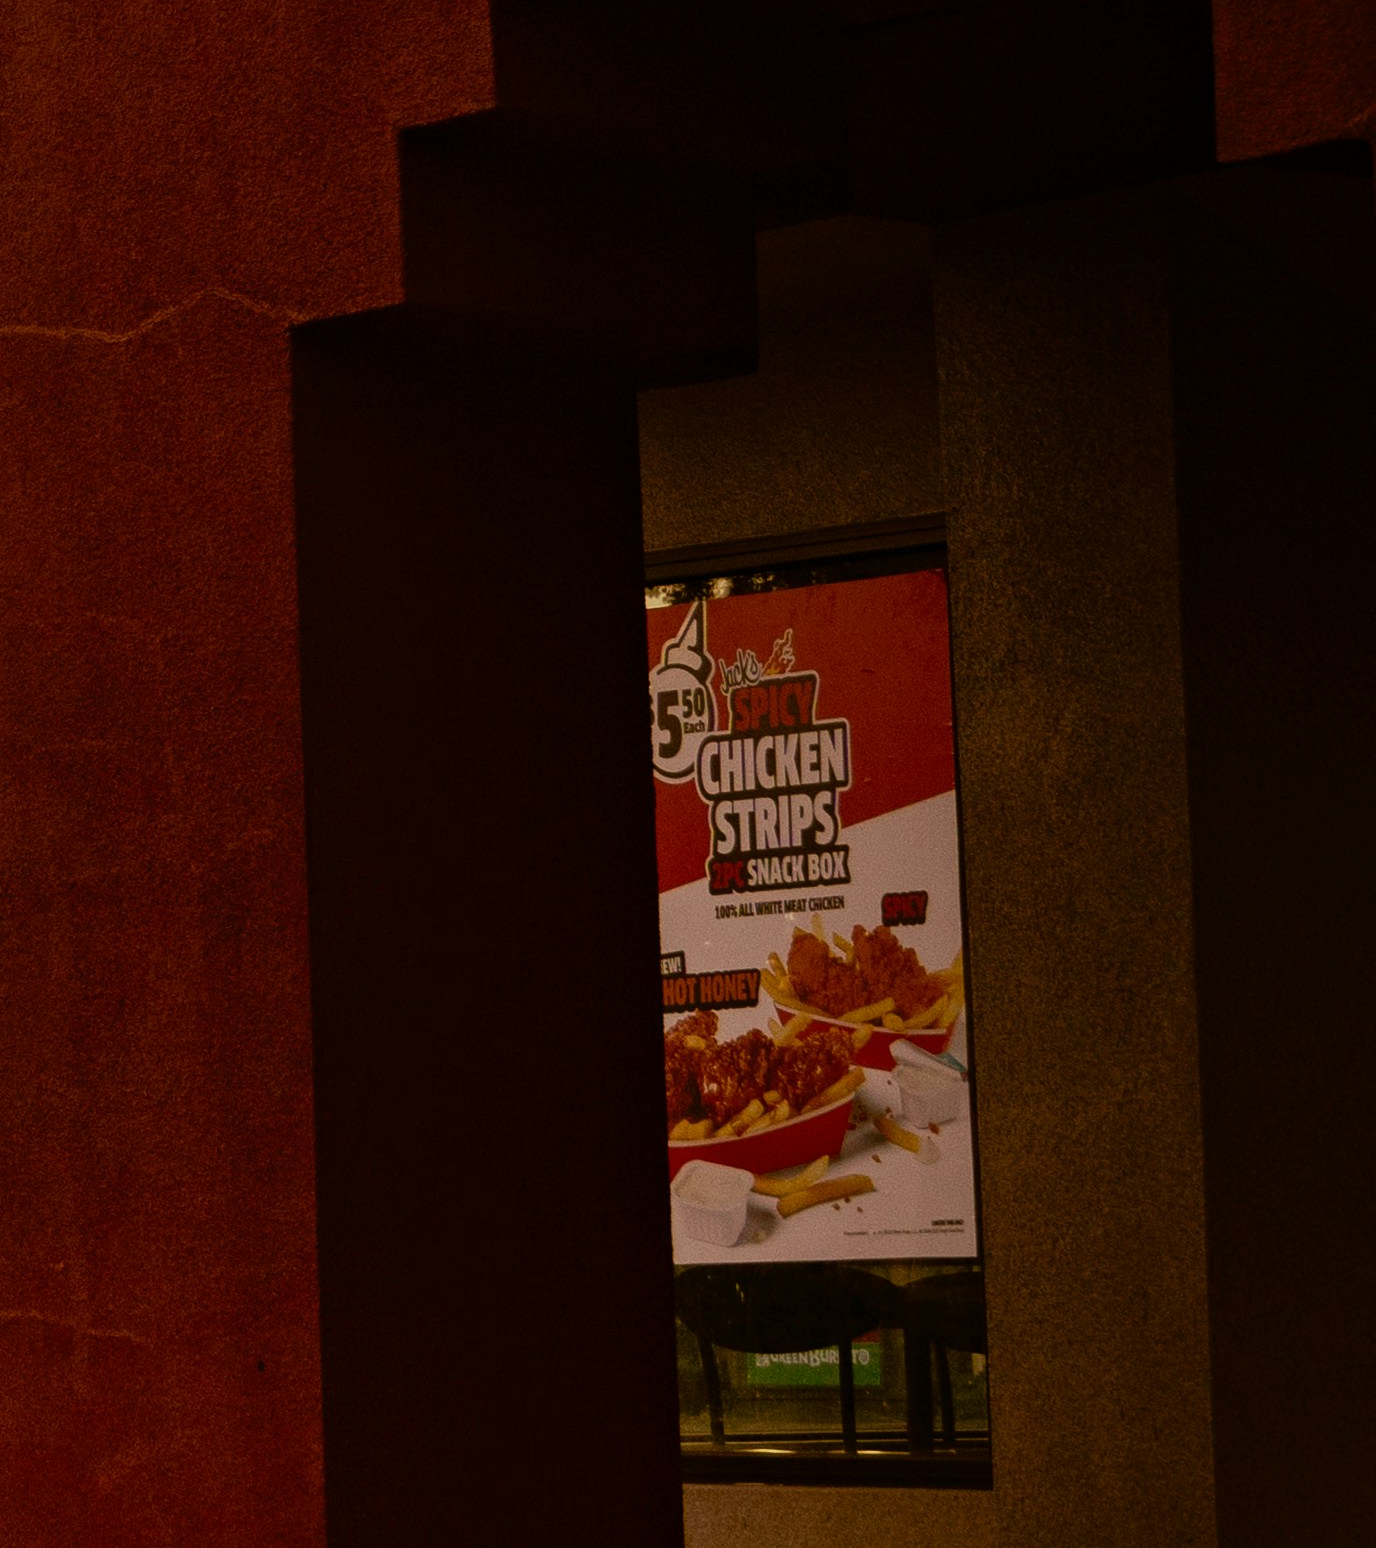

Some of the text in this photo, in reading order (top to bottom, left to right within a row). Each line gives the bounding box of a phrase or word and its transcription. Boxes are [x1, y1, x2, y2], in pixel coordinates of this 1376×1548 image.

[719, 648, 763, 696] Jack's
[684, 720, 705, 734] Each
[734, 682, 813, 731] SPICY
[701, 727, 846, 796] CHICKEN
[714, 789, 835, 855] STRIPS
[747, 855, 806, 887] SNACK
[808, 850, 847, 882] BOX
[715, 895, 845, 919] 100% ALL WHITE MEAT CHICKEN
[662, 971, 758, 1007] HOT HONEY
